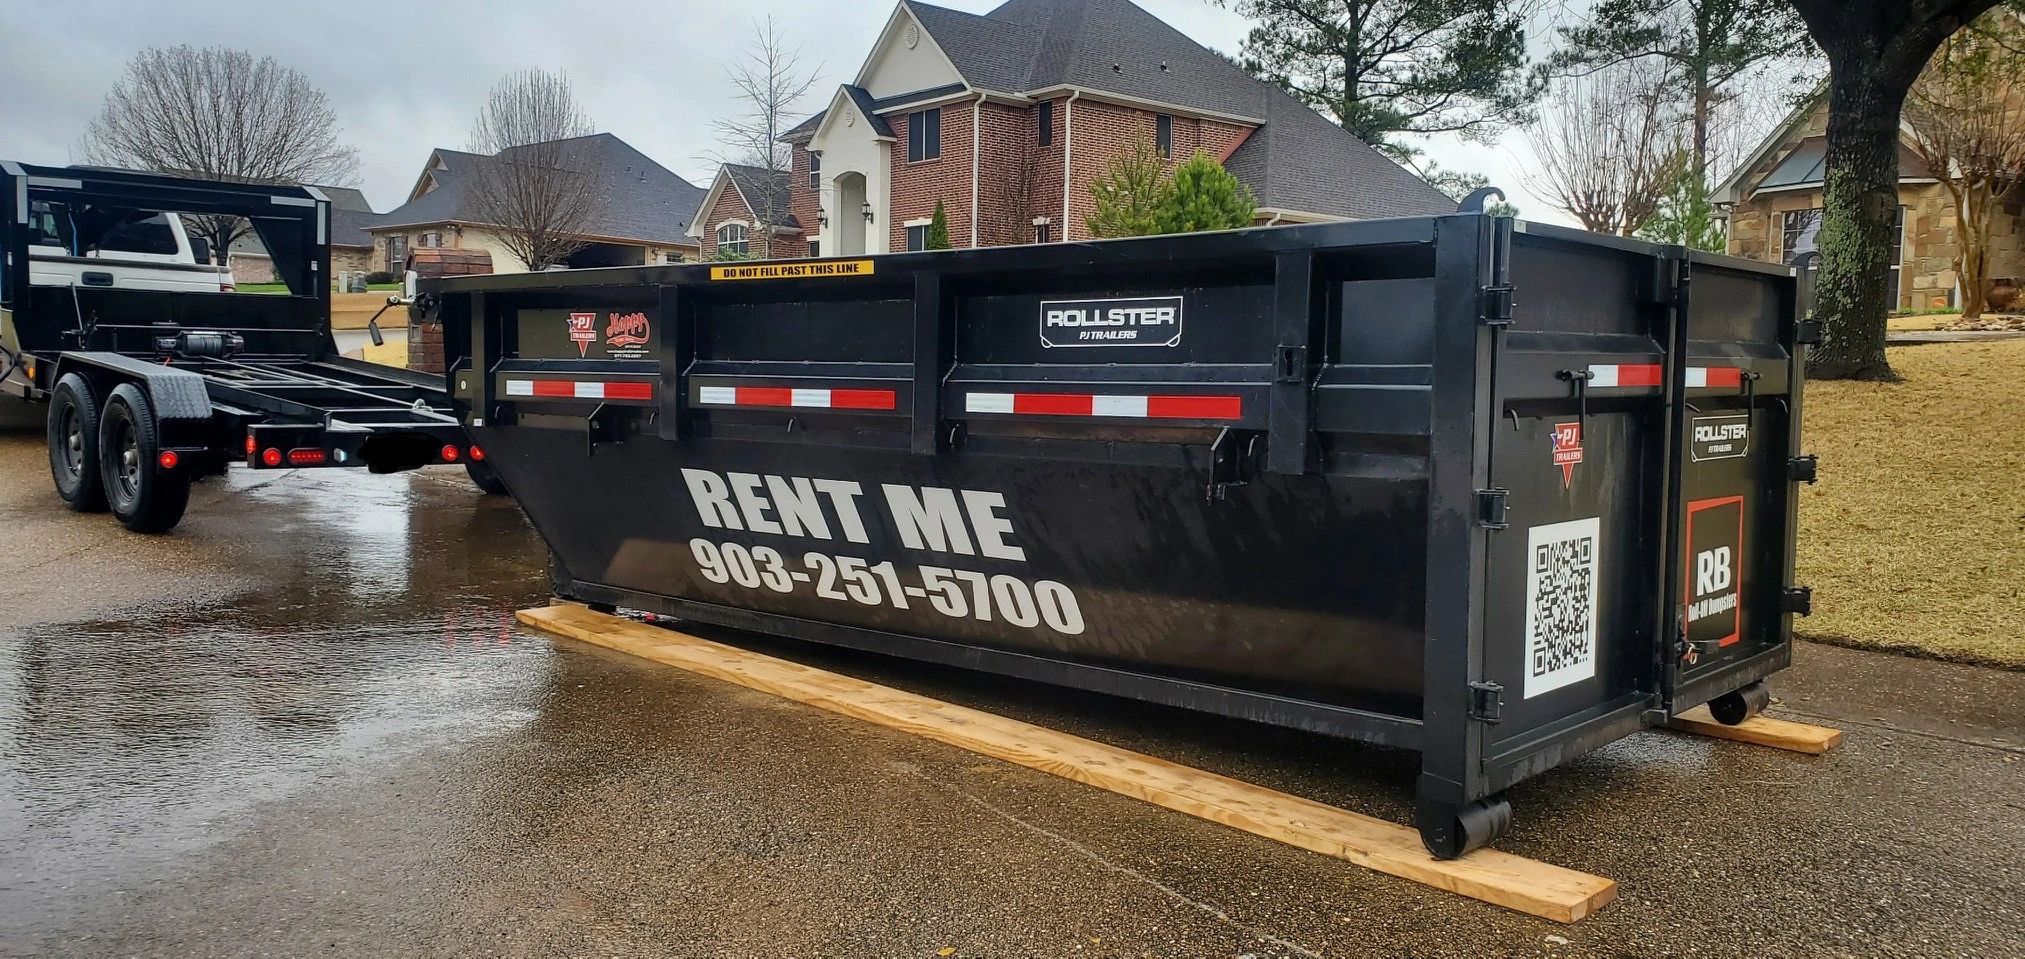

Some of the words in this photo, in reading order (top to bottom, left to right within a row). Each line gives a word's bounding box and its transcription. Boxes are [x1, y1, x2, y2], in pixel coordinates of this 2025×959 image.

[723, 269, 736, 277] DO
[739, 268, 758, 277] NOT
[760, 267, 779, 276] FILL
[781, 266, 807, 275] PAST
[809, 265, 834, 274] THIS
[836, 263, 859, 273] LINE
[577, 316, 590, 329] PJ
[1047, 307, 1175, 327] ROLLSTER
[1079, 331, 1090, 340] PJ
[1091, 330, 1138, 340] TRAILERS
[1561, 428, 1577, 446] PJ
[1694, 424, 1747, 442] ROLLSTER
[1556, 451, 1581, 461] TRAILERS
[680, 467, 870, 544] RENT
[881, 483, 1027, 562] ME
[1696, 545, 1731, 597] RB
[689, 537, 1086, 636] 903-251-5700
[1687, 599, 1709, 622] Roll-Off
[1709, 593, 1737, 616] Dumpsters
